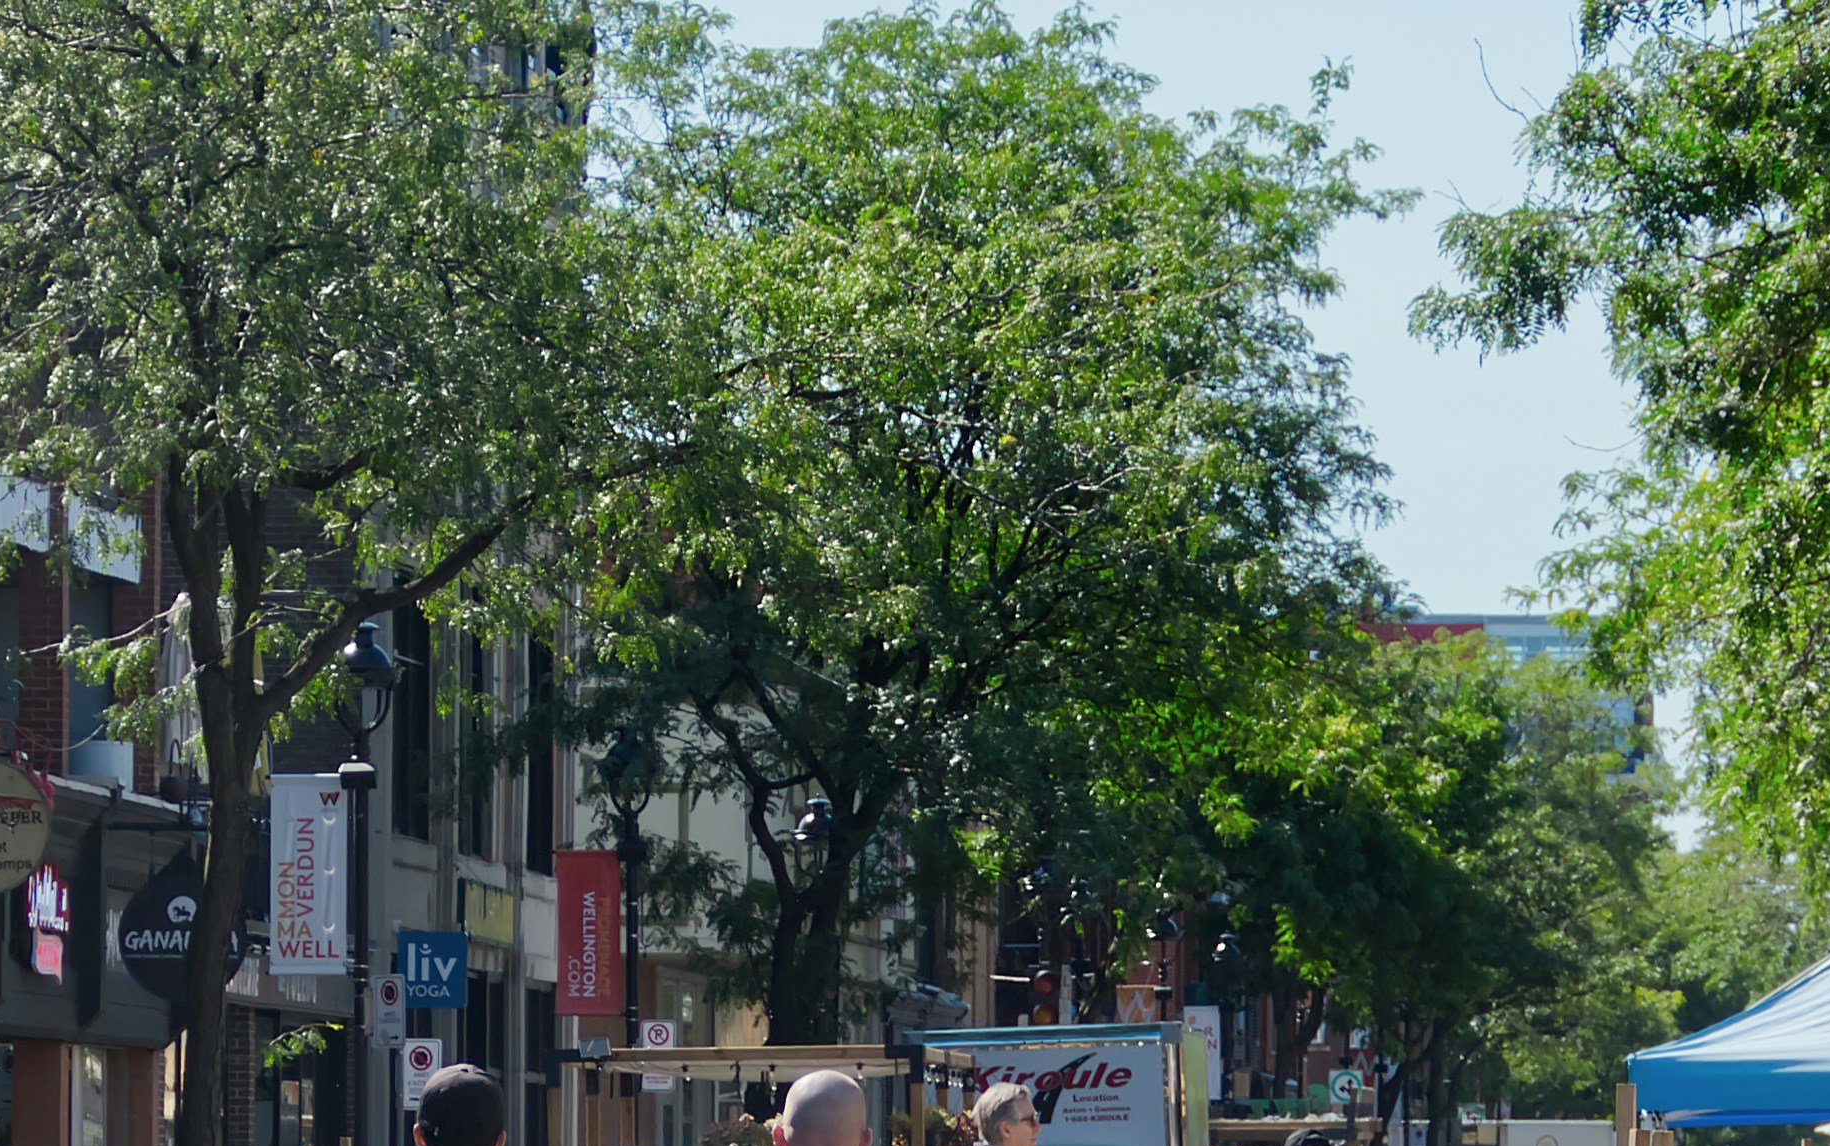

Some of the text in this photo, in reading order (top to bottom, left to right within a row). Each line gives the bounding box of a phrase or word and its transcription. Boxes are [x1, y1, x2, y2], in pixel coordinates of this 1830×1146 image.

[296, 817, 315, 918] VERDUN
[277, 861, 295, 919] MON
[277, 920, 312, 939] MA
[582, 891, 596, 998] WELLINGTON
[278, 939, 340, 959] WELL
[407, 942, 457, 982] liv
[406, 984, 451, 998] YOGA
[567, 955, 581, 998] .COM
[974, 1061, 1132, 1094] Kiroule
[1072, 1093, 1119, 1103] Location
